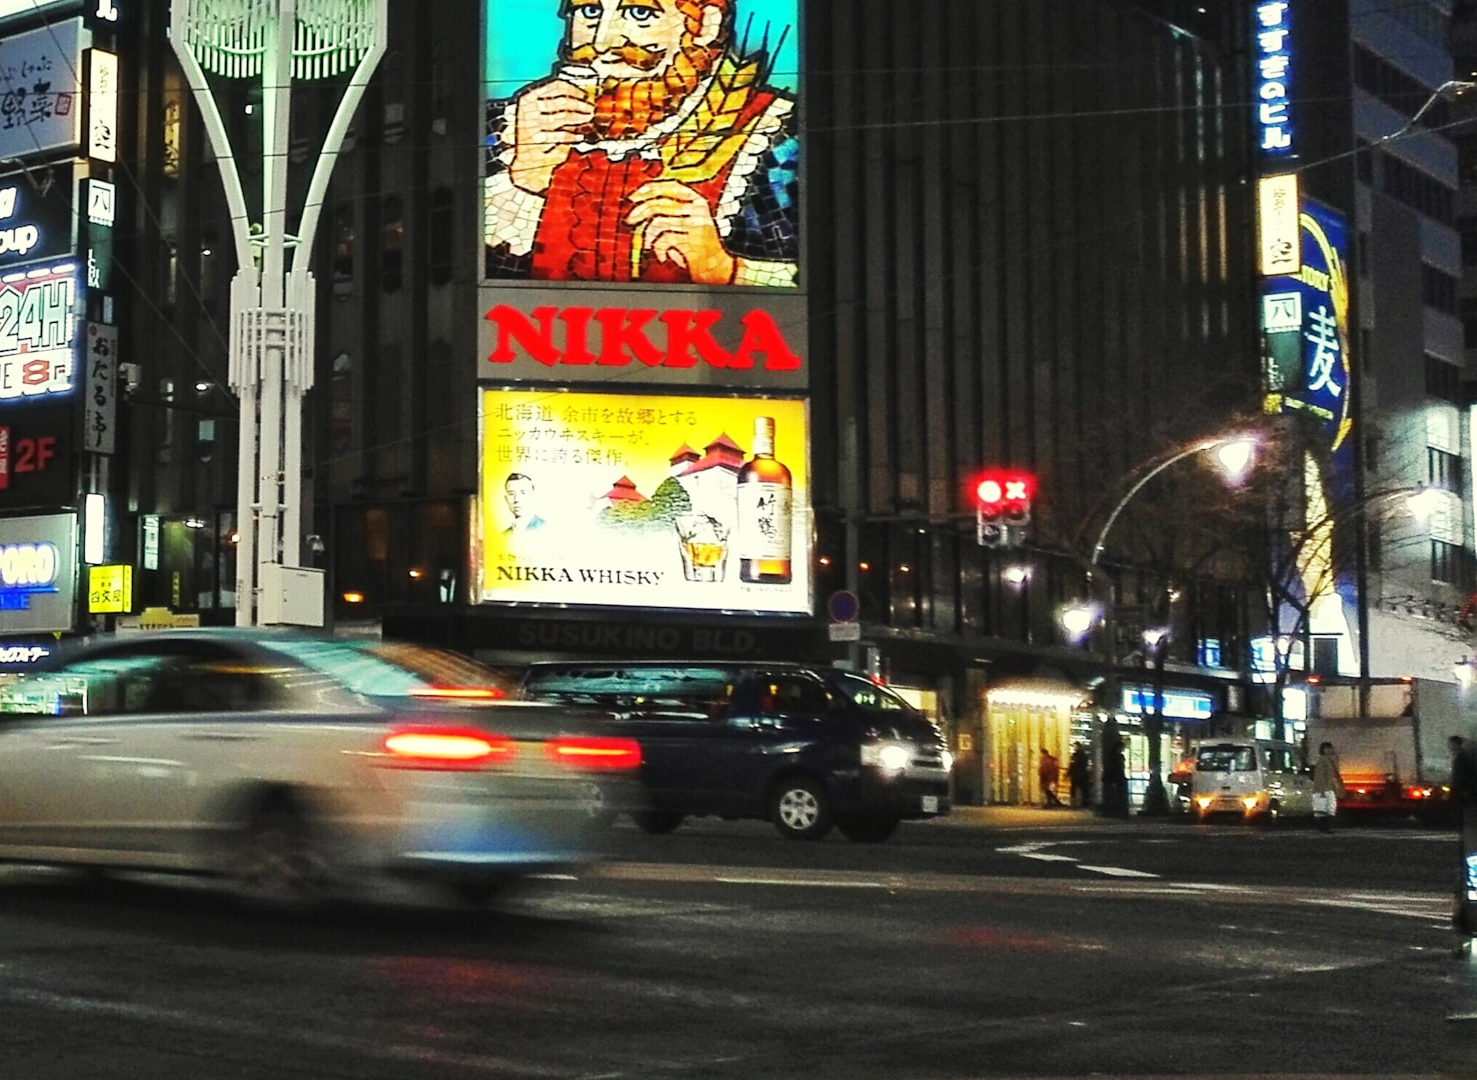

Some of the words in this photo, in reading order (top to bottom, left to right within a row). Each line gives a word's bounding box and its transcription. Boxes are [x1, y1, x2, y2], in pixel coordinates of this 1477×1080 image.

[1256, 1, 1292, 150] すすきのビル
[485, 304, 802, 371] NIKKA
[495, 403, 554, 422] 北海道
[15, 437, 56, 472] 2F
[496, 565, 574, 583] NIKKA
[578, 568, 666, 586] WHISKY
[519, 622, 681, 650] SUSUKINO
[692, 628, 763, 654] BLD.
